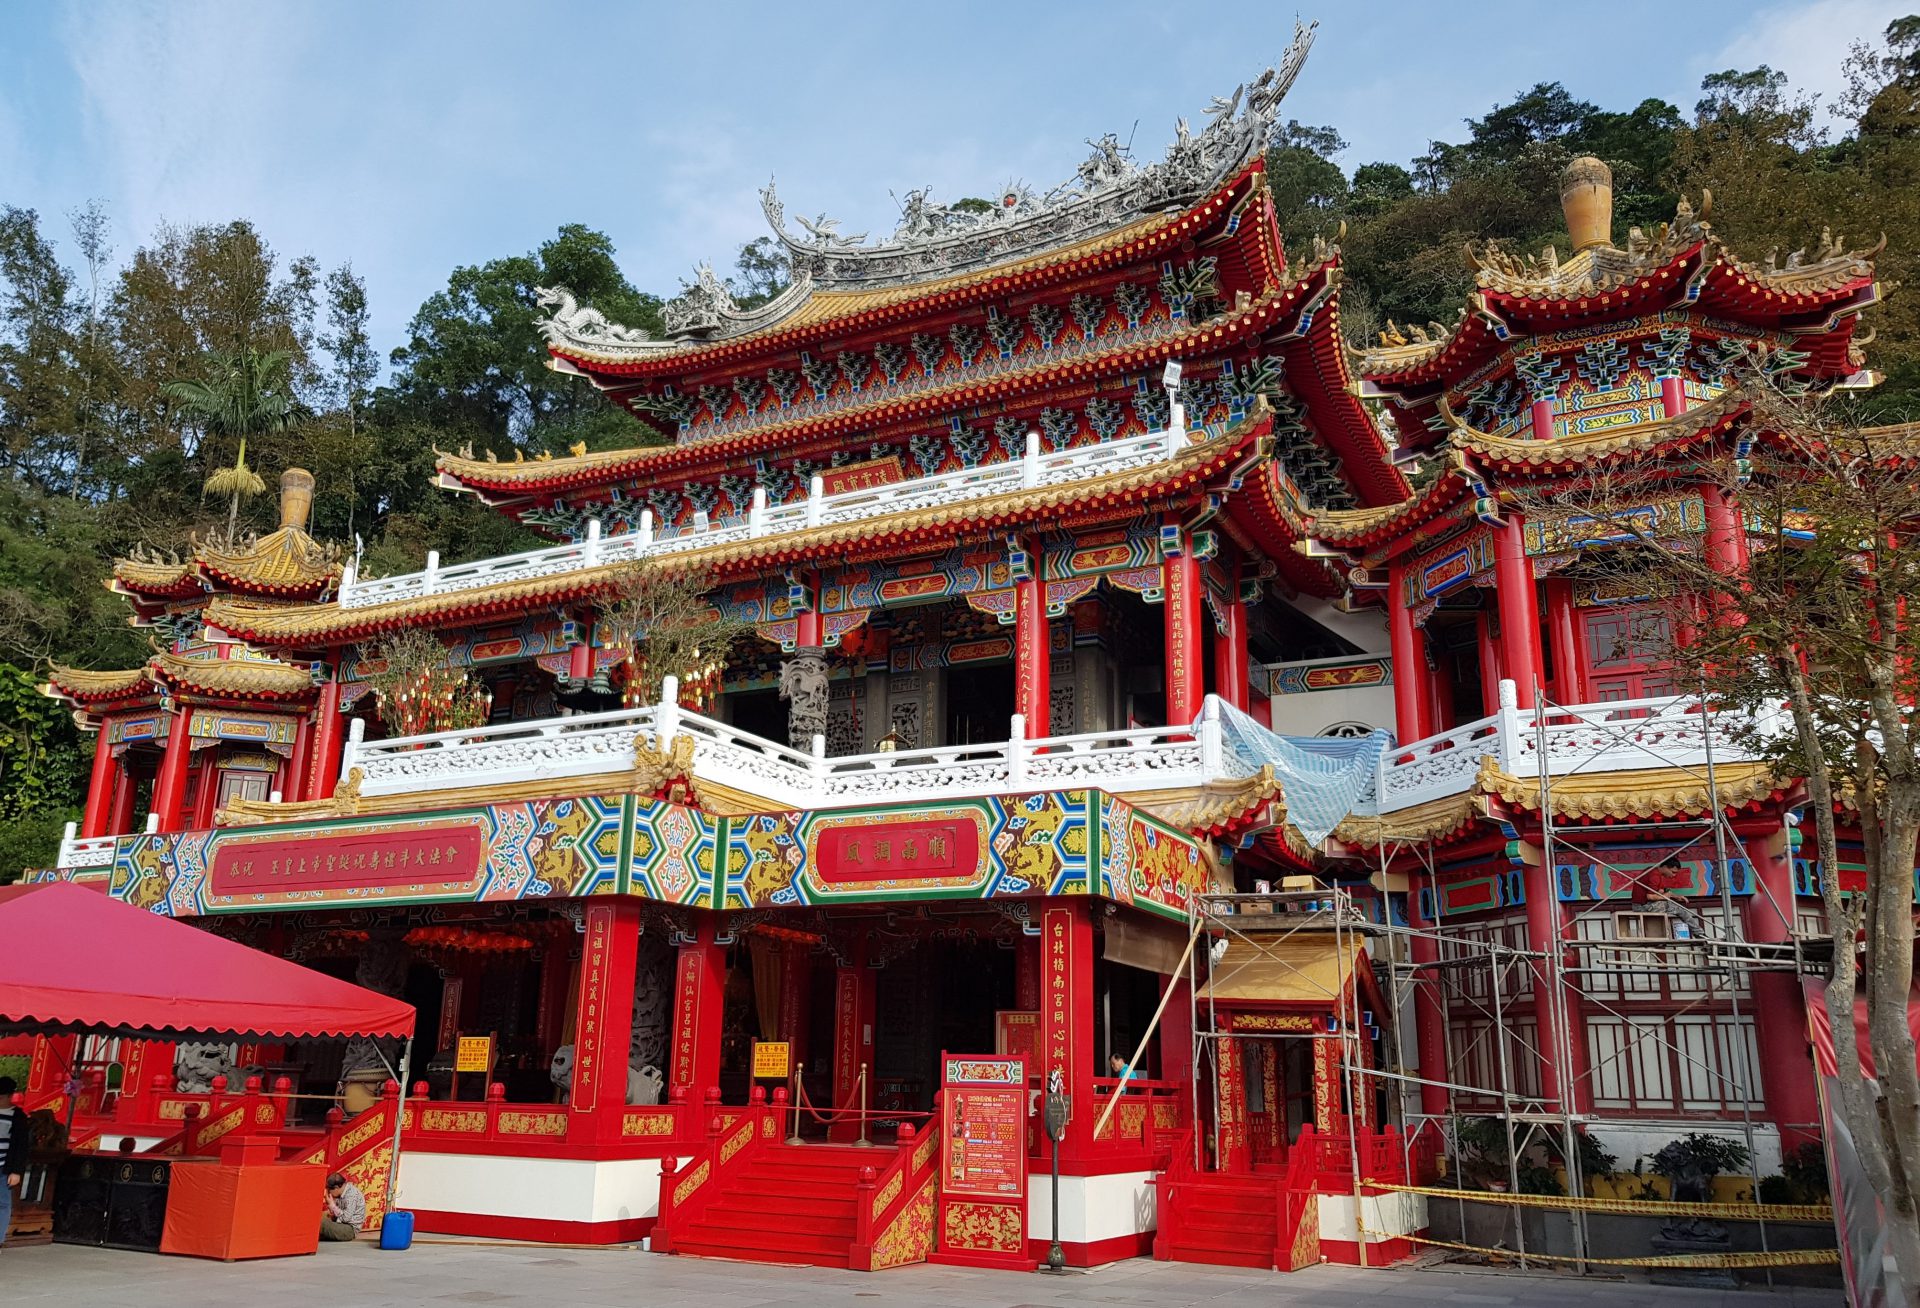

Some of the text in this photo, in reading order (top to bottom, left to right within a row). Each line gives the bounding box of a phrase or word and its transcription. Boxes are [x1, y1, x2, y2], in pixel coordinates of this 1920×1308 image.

[845, 836, 946, 864] 風調雨順
[230, 861, 253, 877] 恭祝
[1052, 923, 1066, 1090] 台北指南宮同心辦法
